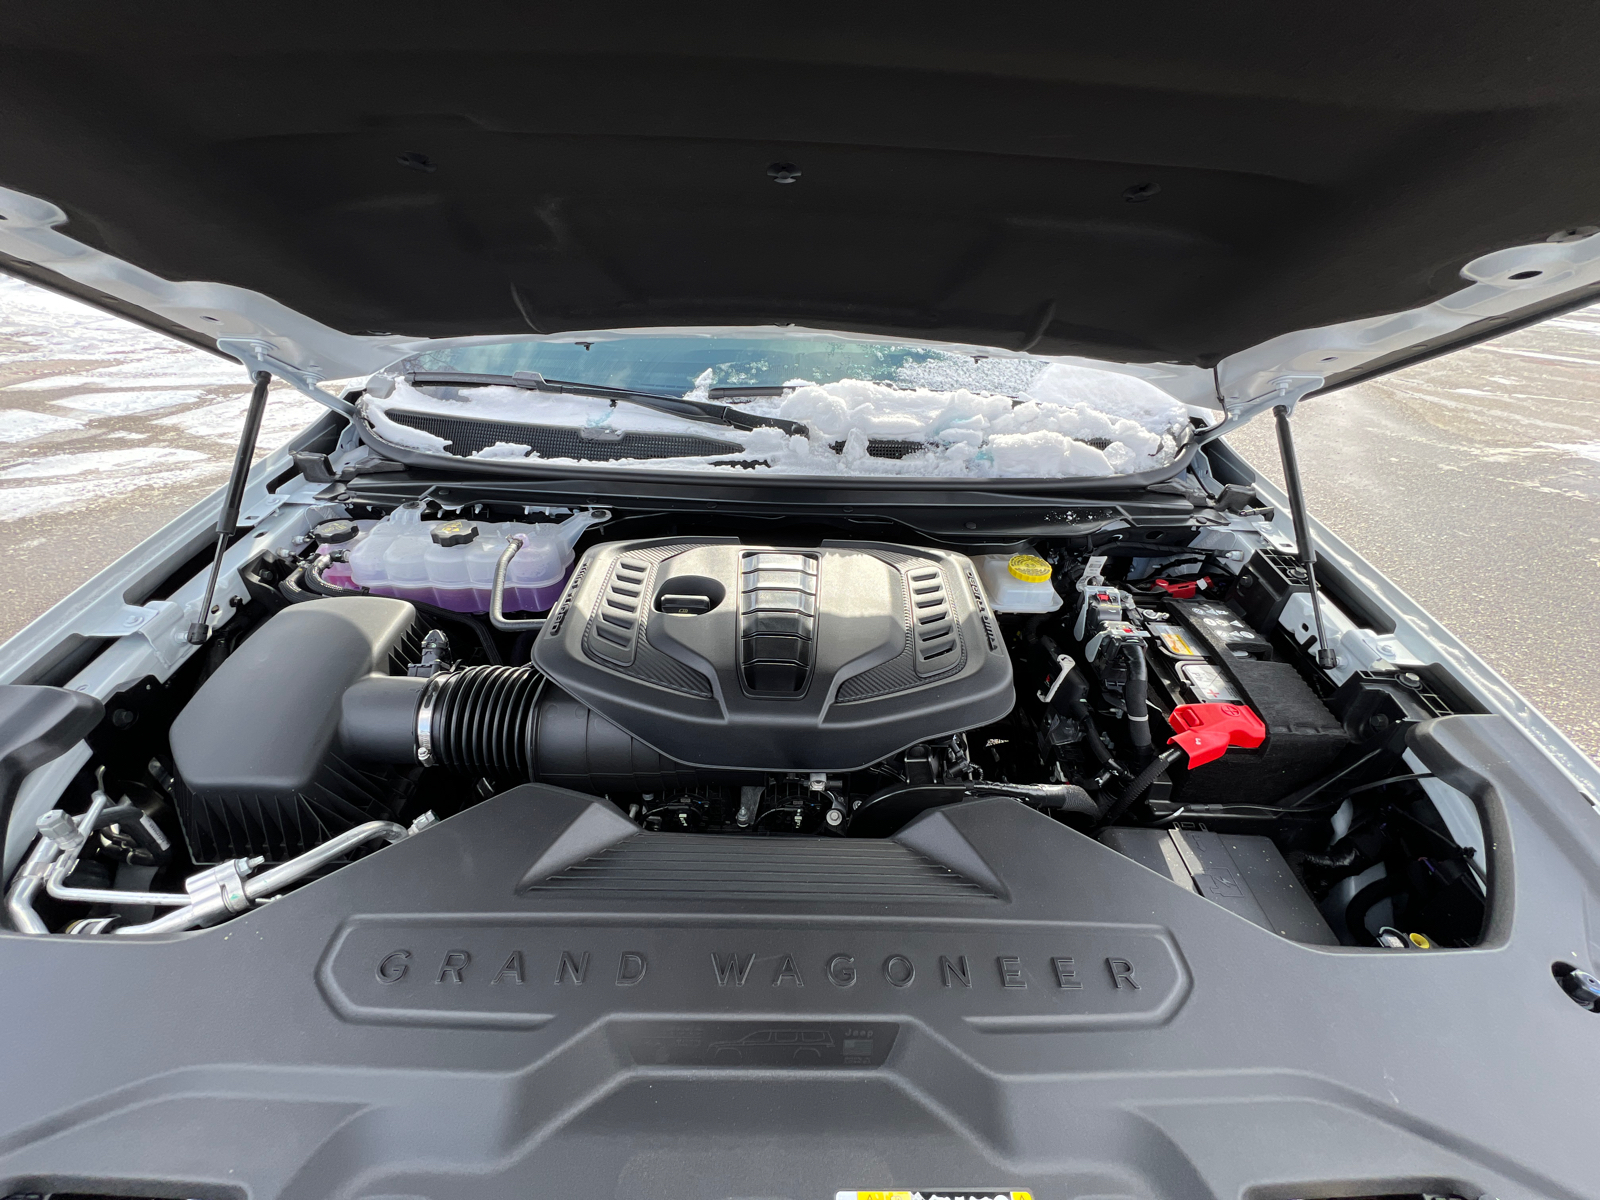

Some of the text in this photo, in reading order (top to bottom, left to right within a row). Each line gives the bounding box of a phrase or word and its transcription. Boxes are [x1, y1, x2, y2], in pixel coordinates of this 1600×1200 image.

[374, 949, 1141, 991] GRAND WAGONEER
[844, 1028, 874, 1039] Jeep
